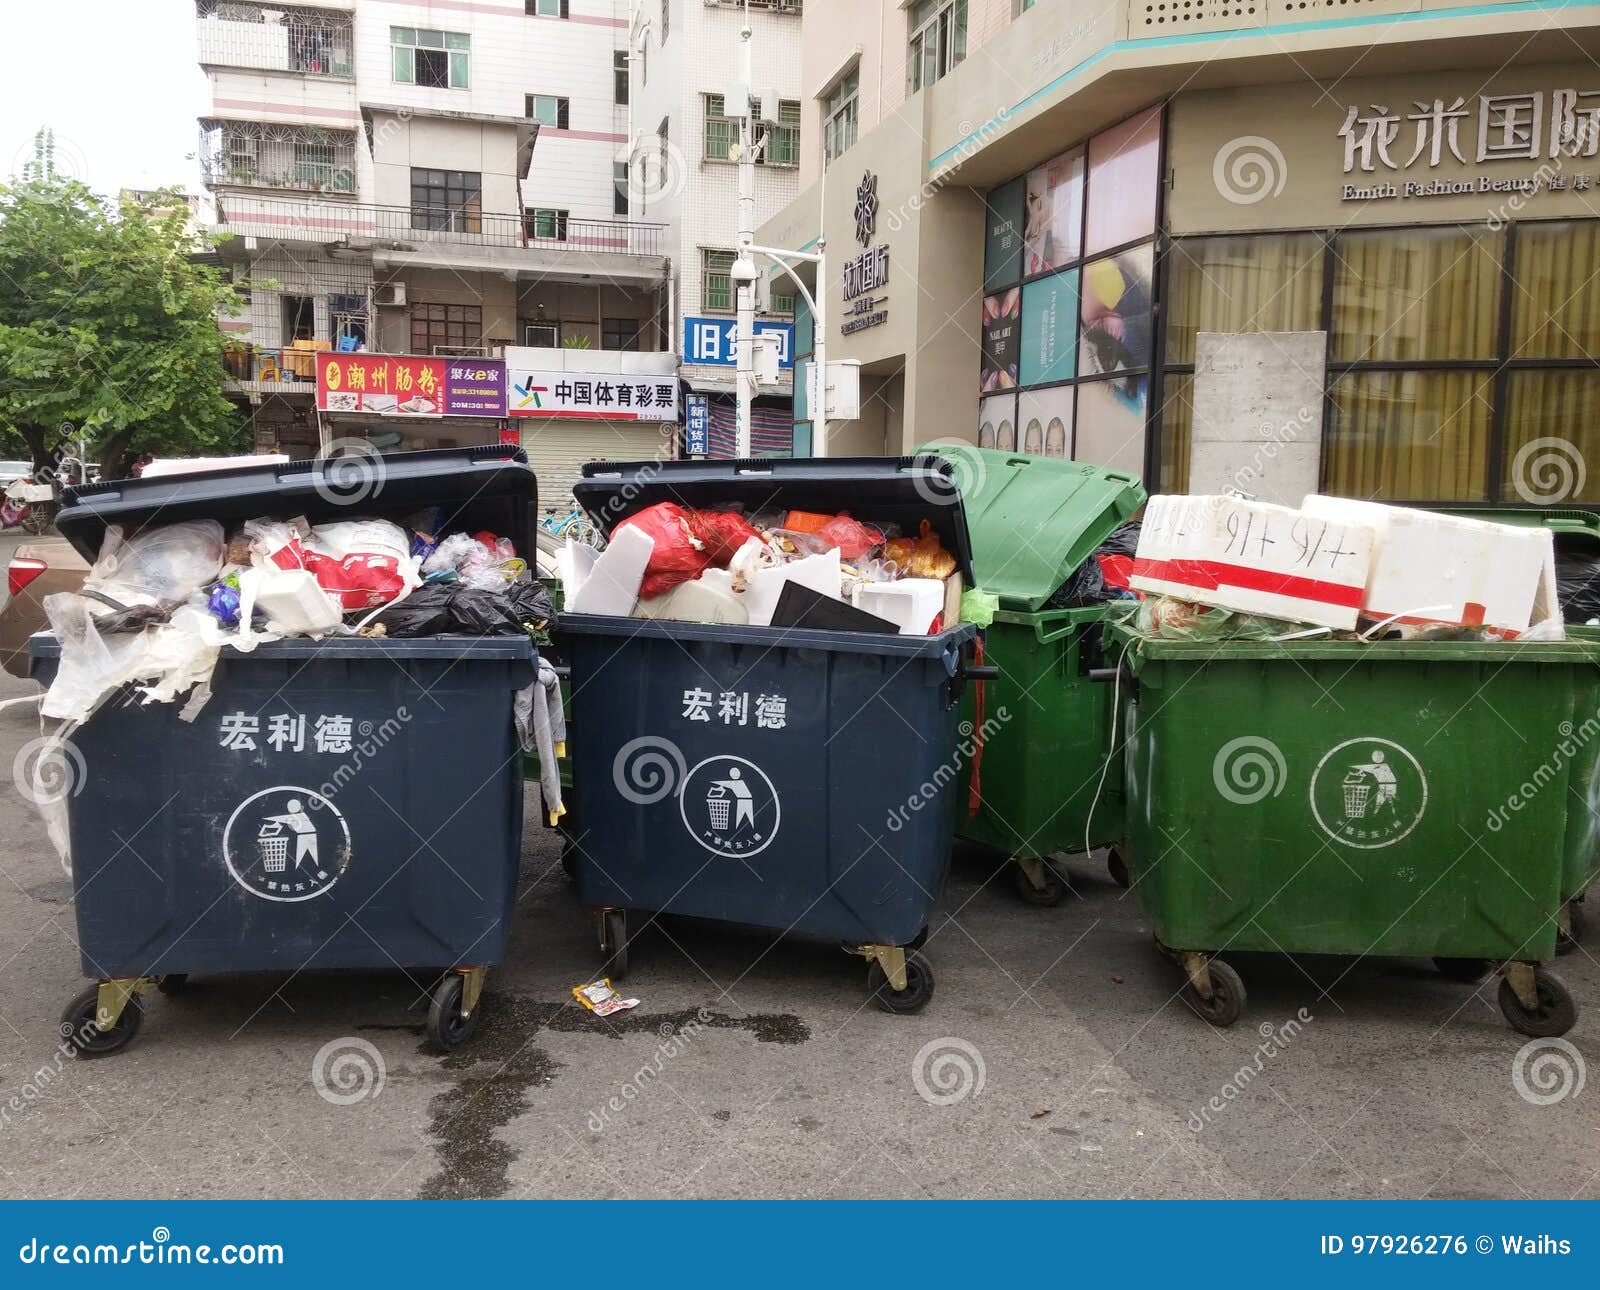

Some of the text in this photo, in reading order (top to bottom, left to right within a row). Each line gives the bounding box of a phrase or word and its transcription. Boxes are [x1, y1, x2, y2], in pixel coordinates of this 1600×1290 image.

[1343, 175, 1541, 201] Emith Fashion Beauty
[1548, 172, 1600, 191] 健康
[347, 362, 438, 395] 潮州肠粉
[555, 379, 674, 408] 中国体育彩票
[681, 687, 787, 729] 宏利德
[219, 711, 353, 754] 宏利德
